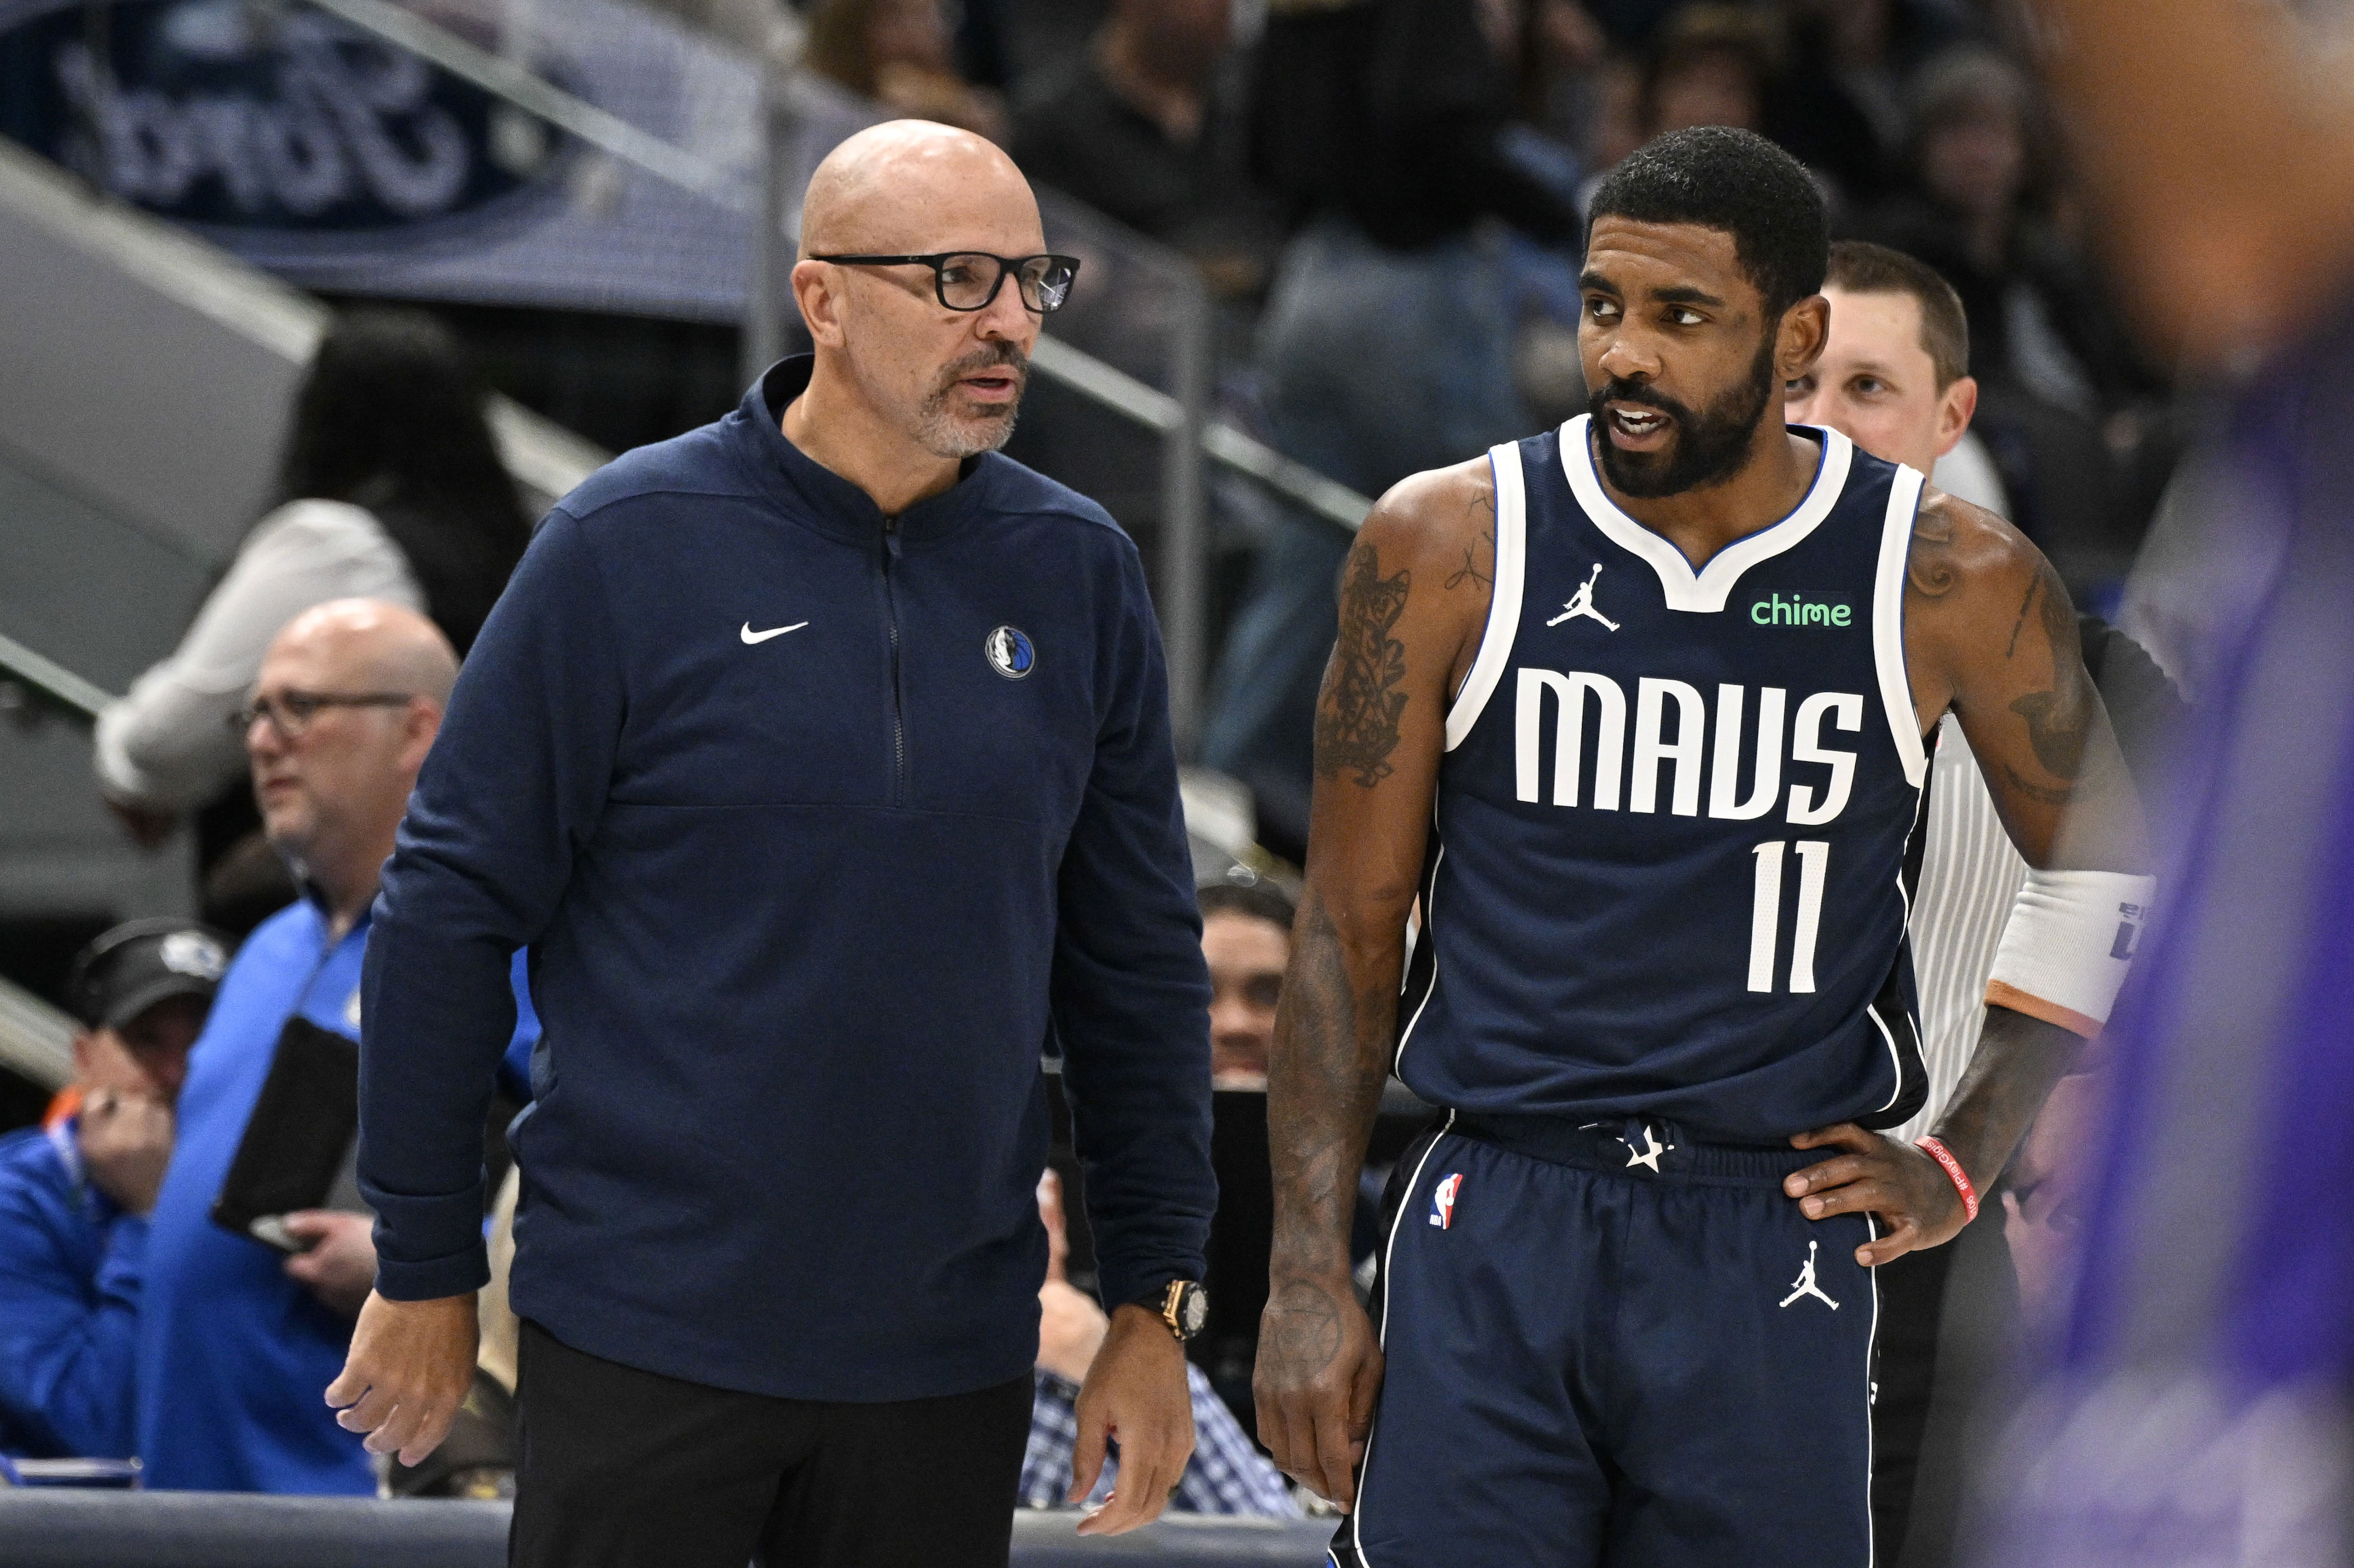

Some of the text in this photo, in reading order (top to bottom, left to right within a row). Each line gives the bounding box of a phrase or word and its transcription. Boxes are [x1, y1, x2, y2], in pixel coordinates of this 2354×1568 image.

[1752, 594, 1852, 627] chime
[1517, 668, 1863, 825] MAVS
[1748, 841, 1829, 993] 11
[1429, 1214, 1442, 1226] NBA
